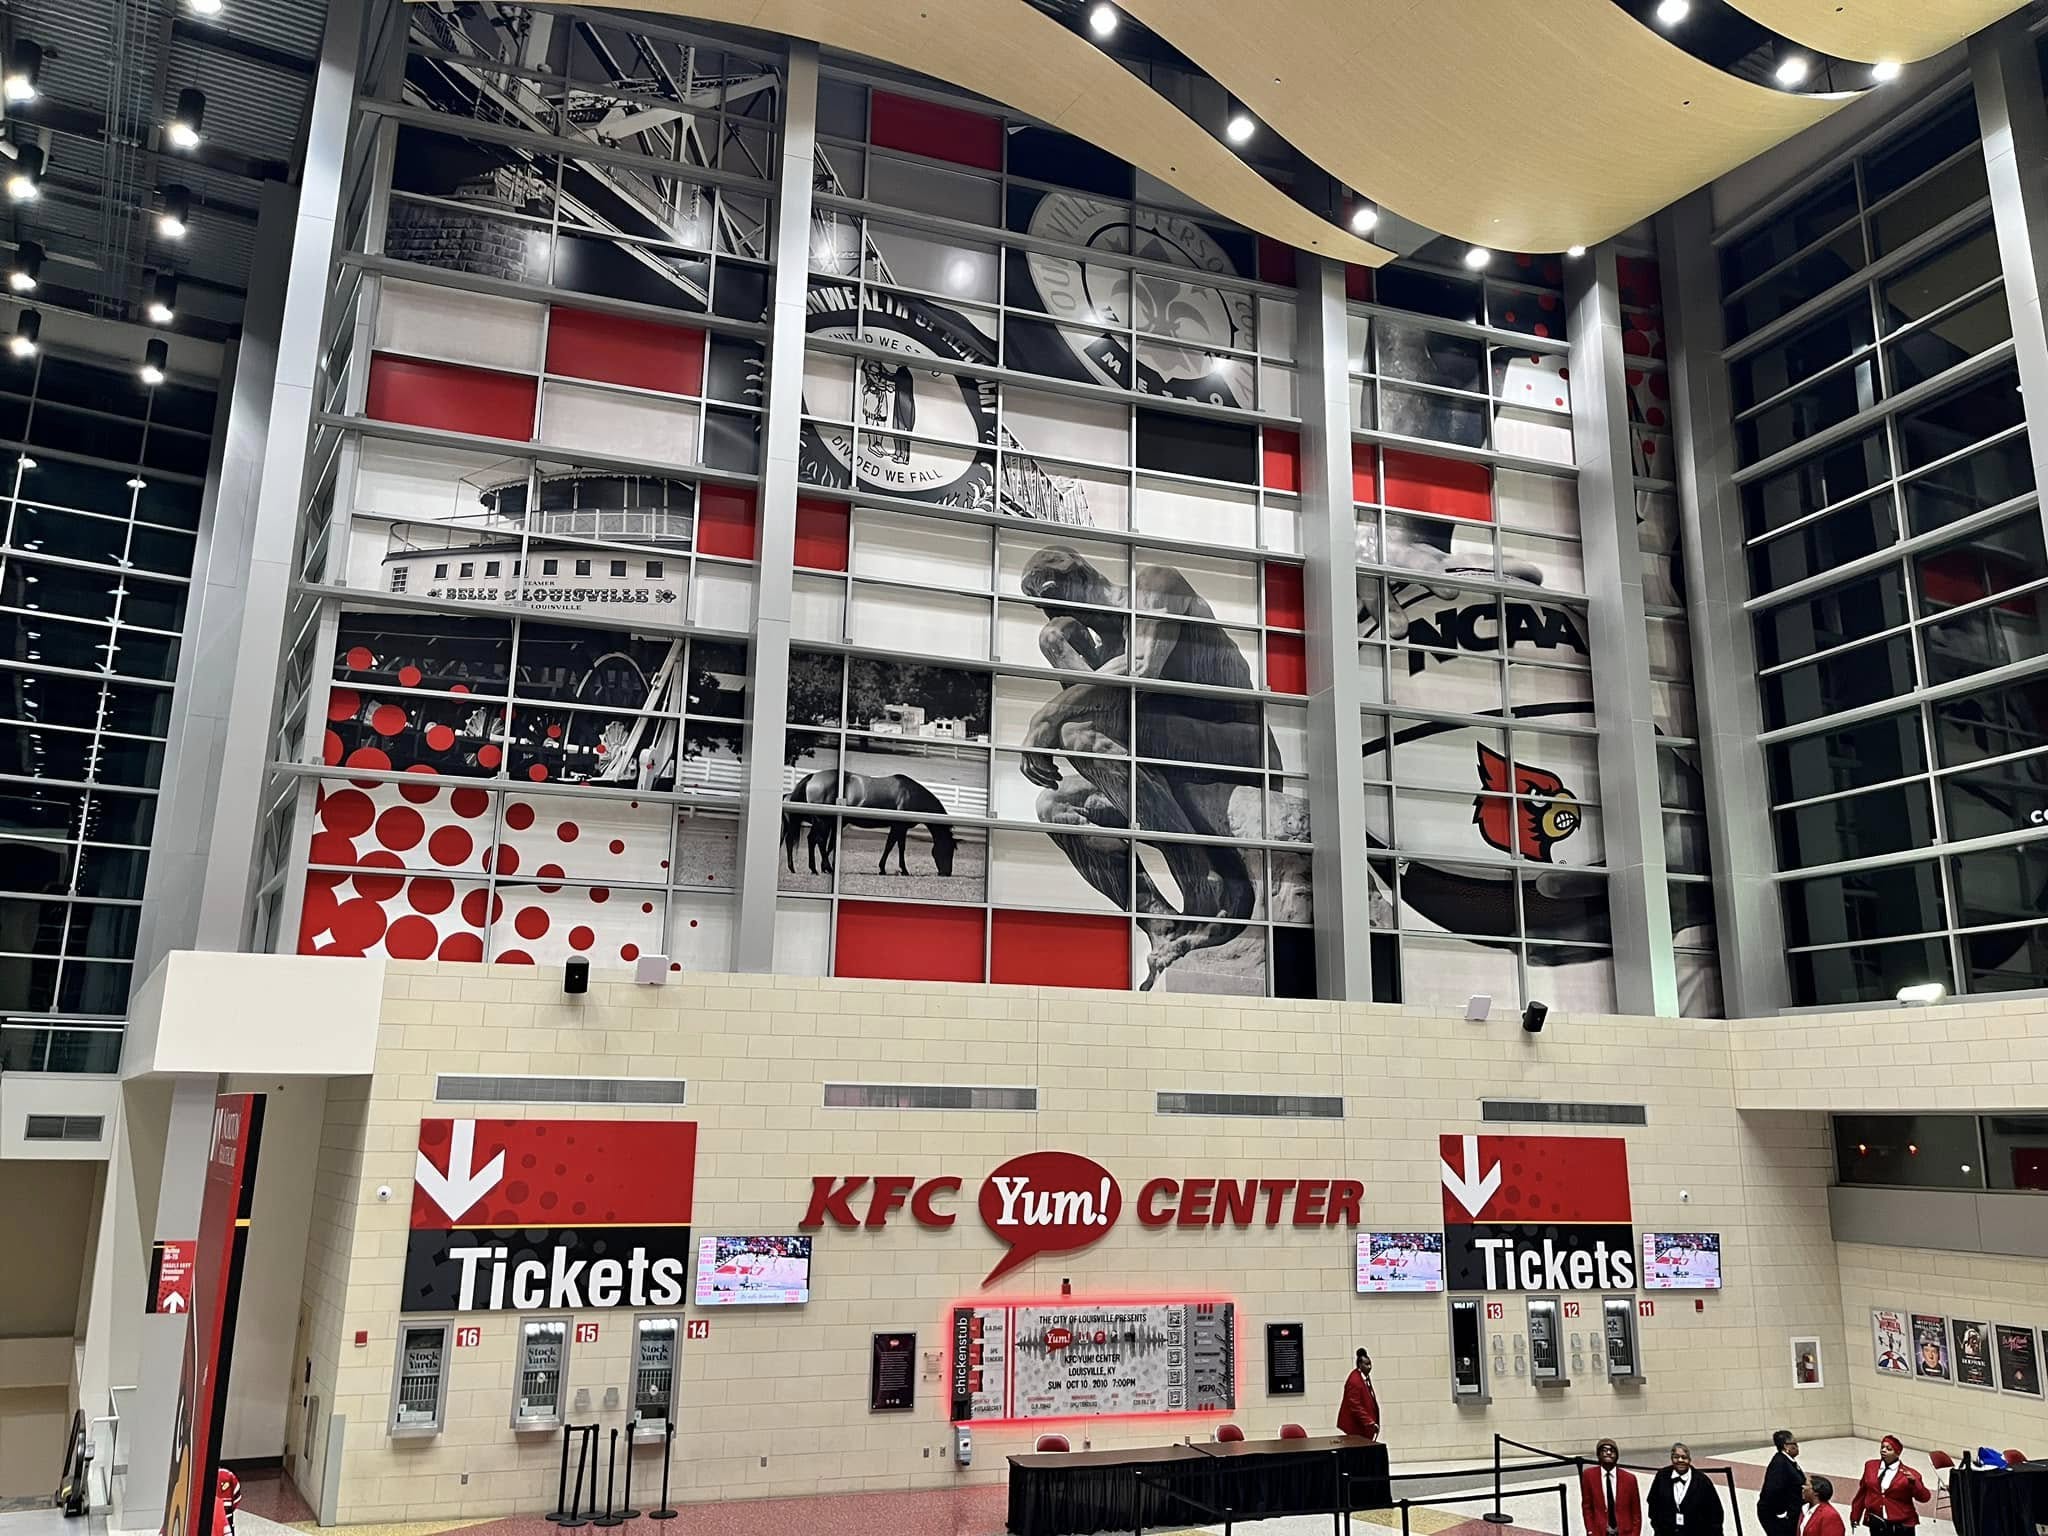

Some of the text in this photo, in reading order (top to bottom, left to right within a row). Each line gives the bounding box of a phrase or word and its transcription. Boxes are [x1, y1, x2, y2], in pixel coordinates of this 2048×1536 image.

[879, 336, 899, 349] WE
[832, 435, 943, 483] DIVDED WE FALL
[446, 588, 498, 600] BELLE
[521, 588, 649, 603] LOUISVILLE
[1408, 603, 1591, 677] NCAA
[798, 1176, 1365, 1228] KFC Yum! CENTER
[1475, 1239, 1634, 1290] Tickets
[448, 1245, 684, 1311] Tickets
[1489, 1304, 1502, 1318] 13
[1566, 1303, 1579, 1317] 12
[1640, 1302, 1653, 1316] 11
[1040, 1313, 1147, 1324] THE CITY OF LOUISVILLE PRESENTS
[578, 1324, 597, 1342] 15
[689, 1321, 707, 1338] 14
[459, 1328, 478, 1346] 16
[1047, 1333, 1071, 1344] Yum!
[528, 1347, 556, 1356] Stock
[641, 1344, 668, 1353] Stock
[955, 1317, 968, 1394] chickenstub
[409, 1352, 438, 1361] Stock
[528, 1355, 556, 1364] Yards
[640, 1352, 668, 1361] Yards
[1064, 1355, 1077, 1364] KFC
[1095, 1353, 1120, 1362] CENTER
[408, 1360, 438, 1369] Yards
[1107, 1366, 1116, 1375] KY
[1048, 1380, 1061, 1390] SUN
[1066, 1380, 1079, 1389] OCT
[1080, 1379, 1088, 1389] 10
[1092, 1379, 1108, 1388] 2010
